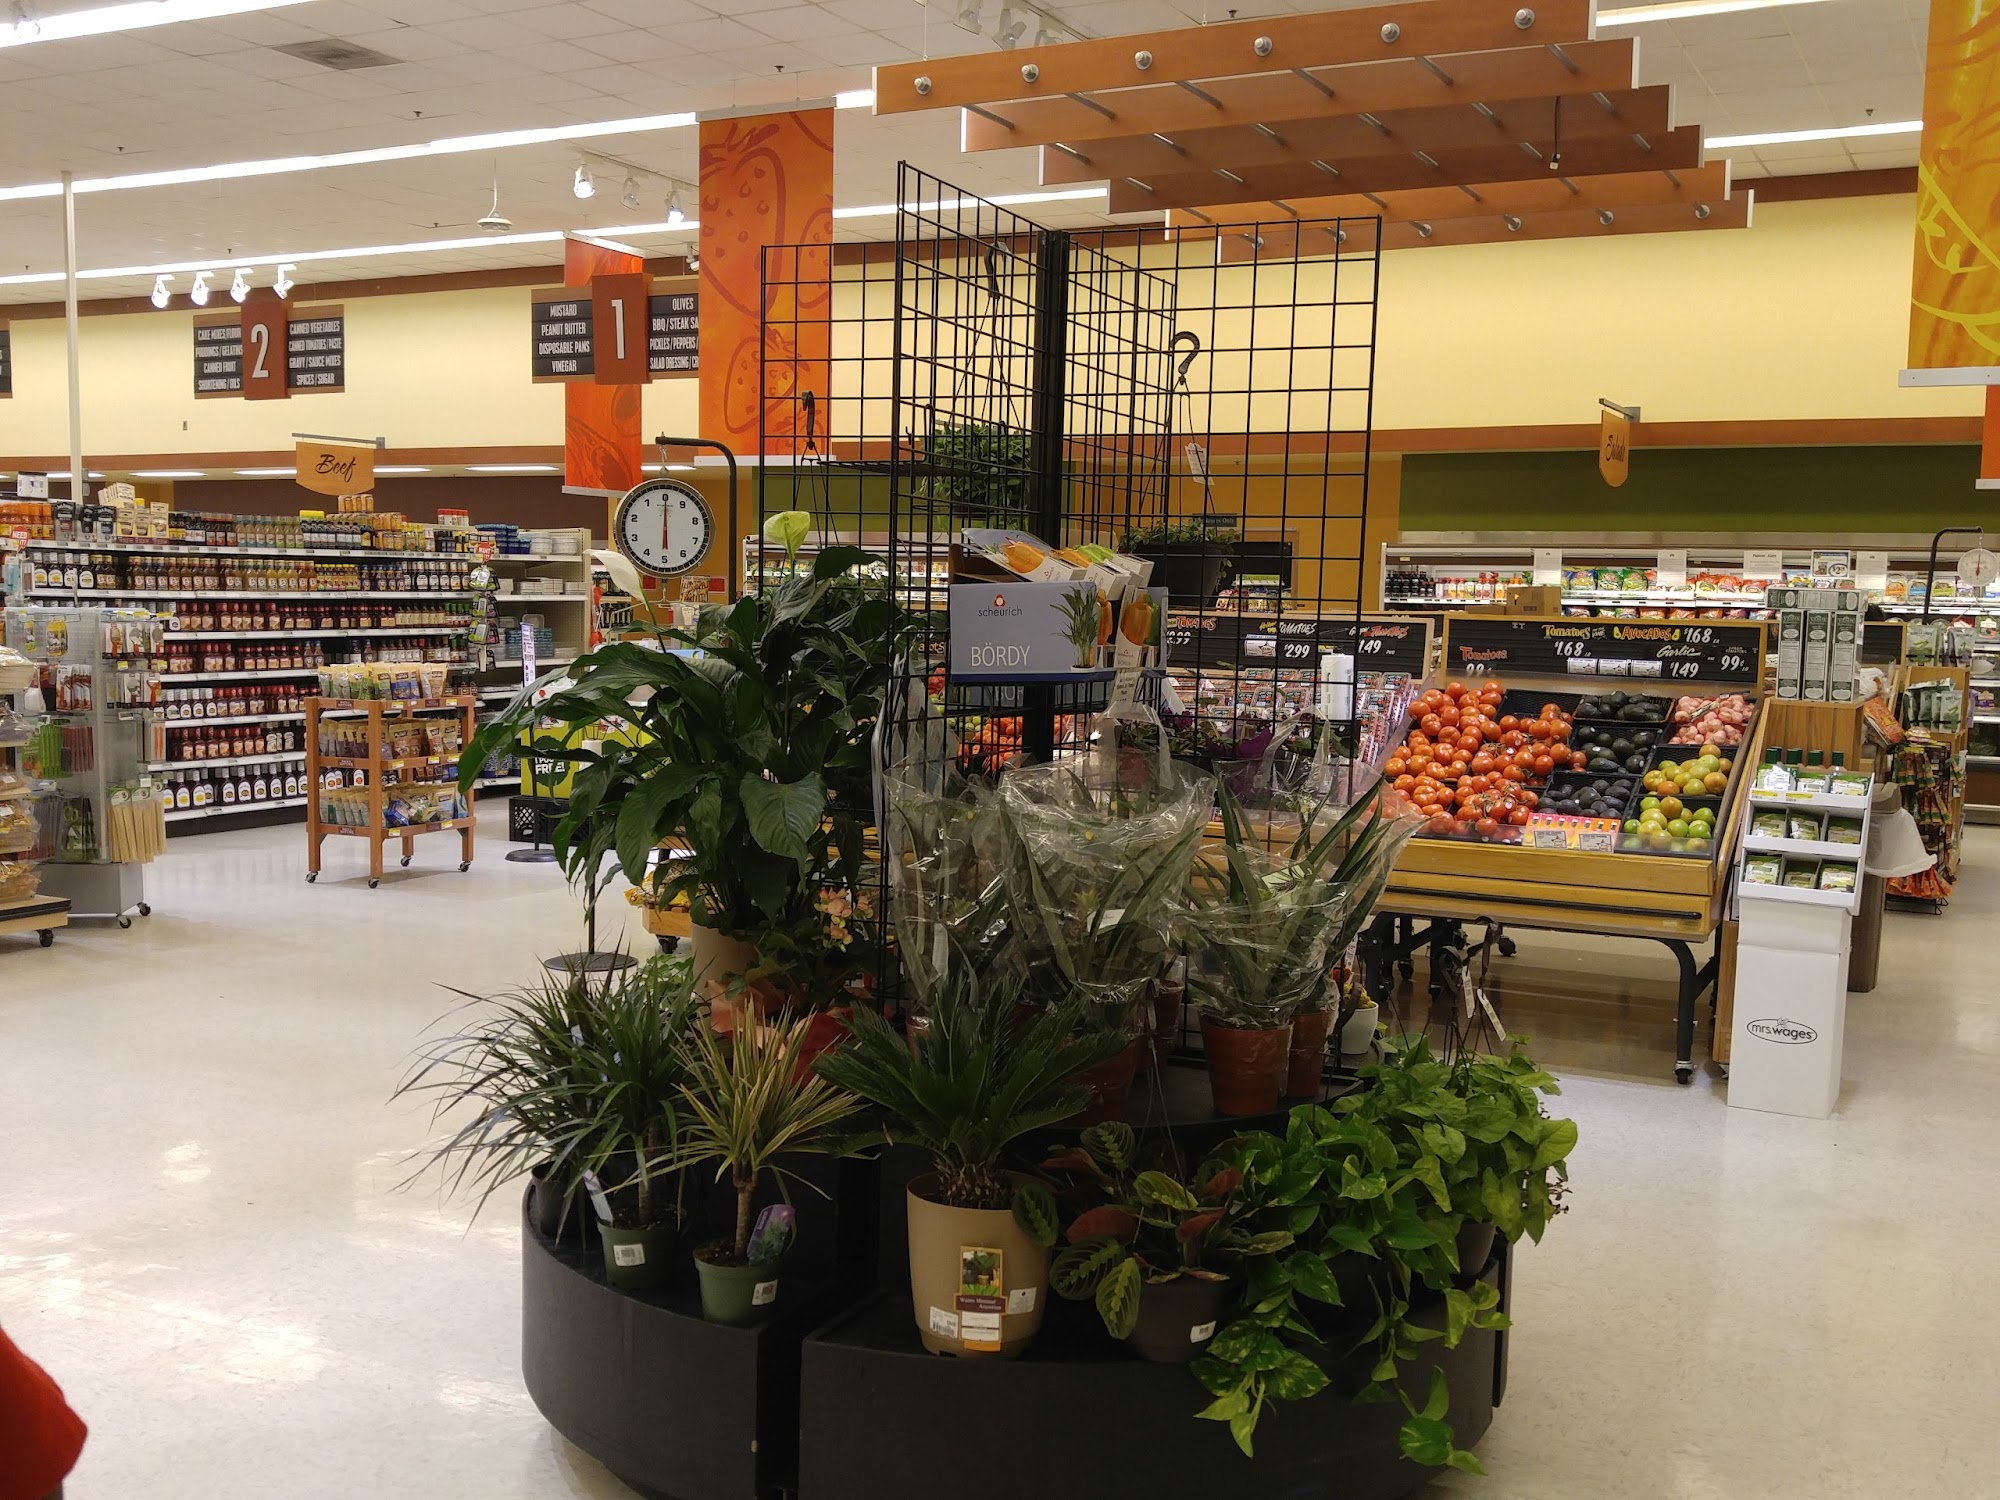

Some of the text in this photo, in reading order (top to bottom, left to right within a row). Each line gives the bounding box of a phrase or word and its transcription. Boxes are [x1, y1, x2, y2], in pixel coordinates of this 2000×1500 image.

[672, 297, 694, 311] OLIVES
[549, 304, 578, 317] MUSTARD
[289, 320, 341, 335] CANNED VEGETABLES
[541, 322, 587, 336] PEANUT BUTTER
[611, 298, 625, 360] 1
[198, 329, 211, 341] CAKE
[250, 323, 269, 379] 2
[289, 340, 306, 352] CANNED
[538, 340, 590, 355] DISPOSABLE PANS
[203, 360, 237, 374] CANNED FRUIT
[325, 355, 341, 367] MIXES
[551, 360, 578, 373] VINEGAR
[650, 357, 665, 370] SALAD
[315, 453, 356, 483] Beef
[644, 499, 650, 507] 1
[662, 493, 669, 502] 0
[679, 500, 686, 509] 9
[631, 514, 638, 523] 2
[692, 517, 699, 525] 8
[631, 534, 638, 542] 3
[692, 537, 698, 545] 7
[643, 548, 650, 556] 4
[680, 549, 687, 558] 6
[661, 555, 668, 564] 5
[978, 605, 1023, 617] scheurich
[971, 641, 1031, 667] BÖRDY
[1656, 645, 1701, 658] Garlic
